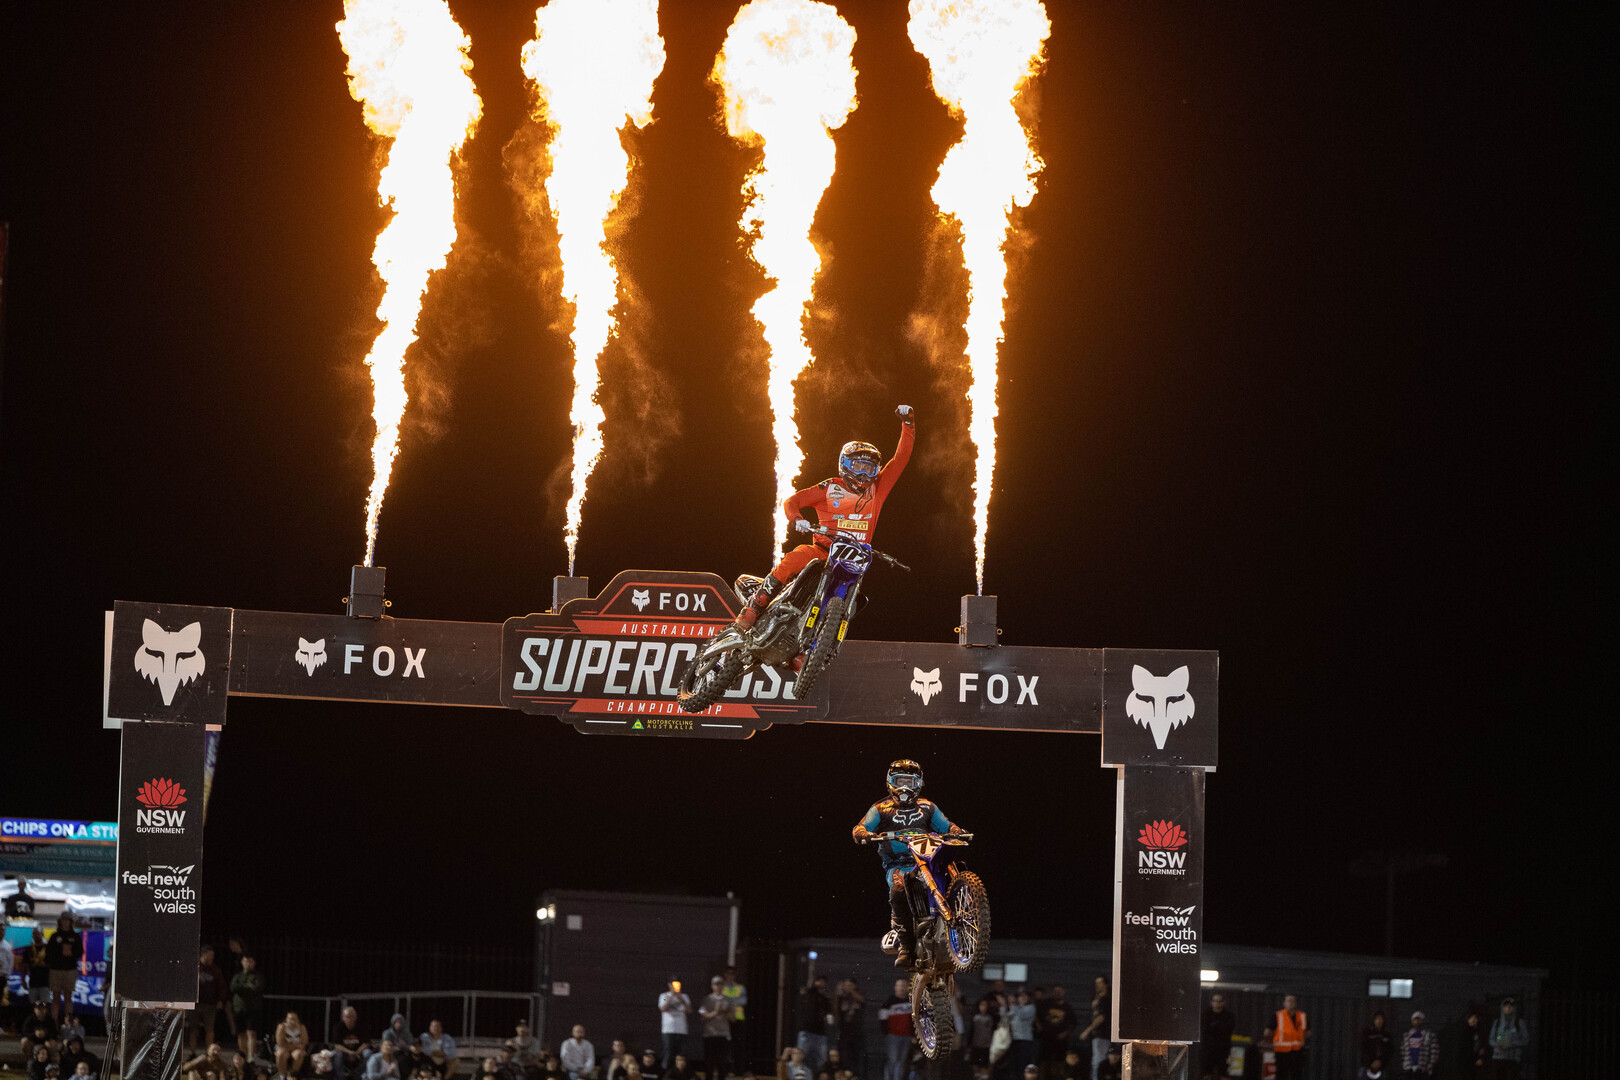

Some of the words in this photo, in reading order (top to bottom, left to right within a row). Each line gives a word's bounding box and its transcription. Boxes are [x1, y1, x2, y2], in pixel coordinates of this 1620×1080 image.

[659, 592, 707, 612] FOX
[620, 623, 715, 637] AUSTRALIAN
[343, 644, 427, 679] FOX
[959, 672, 1040, 706] FOX
[607, 701, 723, 715] CHAMPIONIP
[136, 809, 186, 828] NSW
[2, 820, 48, 836] CHIPS
[50, 823, 75, 838] ON
[77, 824, 88, 837] A
[1138, 851, 1187, 869] NSW
[121, 871, 151, 885] feel
[154, 875, 188, 886] new
[1138, 868, 1186, 876] GOVERNMENT
[154, 886, 195, 901] south
[153, 900, 196, 914] wales
[1125, 911, 1153, 925] feel
[1156, 915, 1189, 926] new
[1156, 927, 1197, 940] south
[1155, 940, 1197, 954] wales
